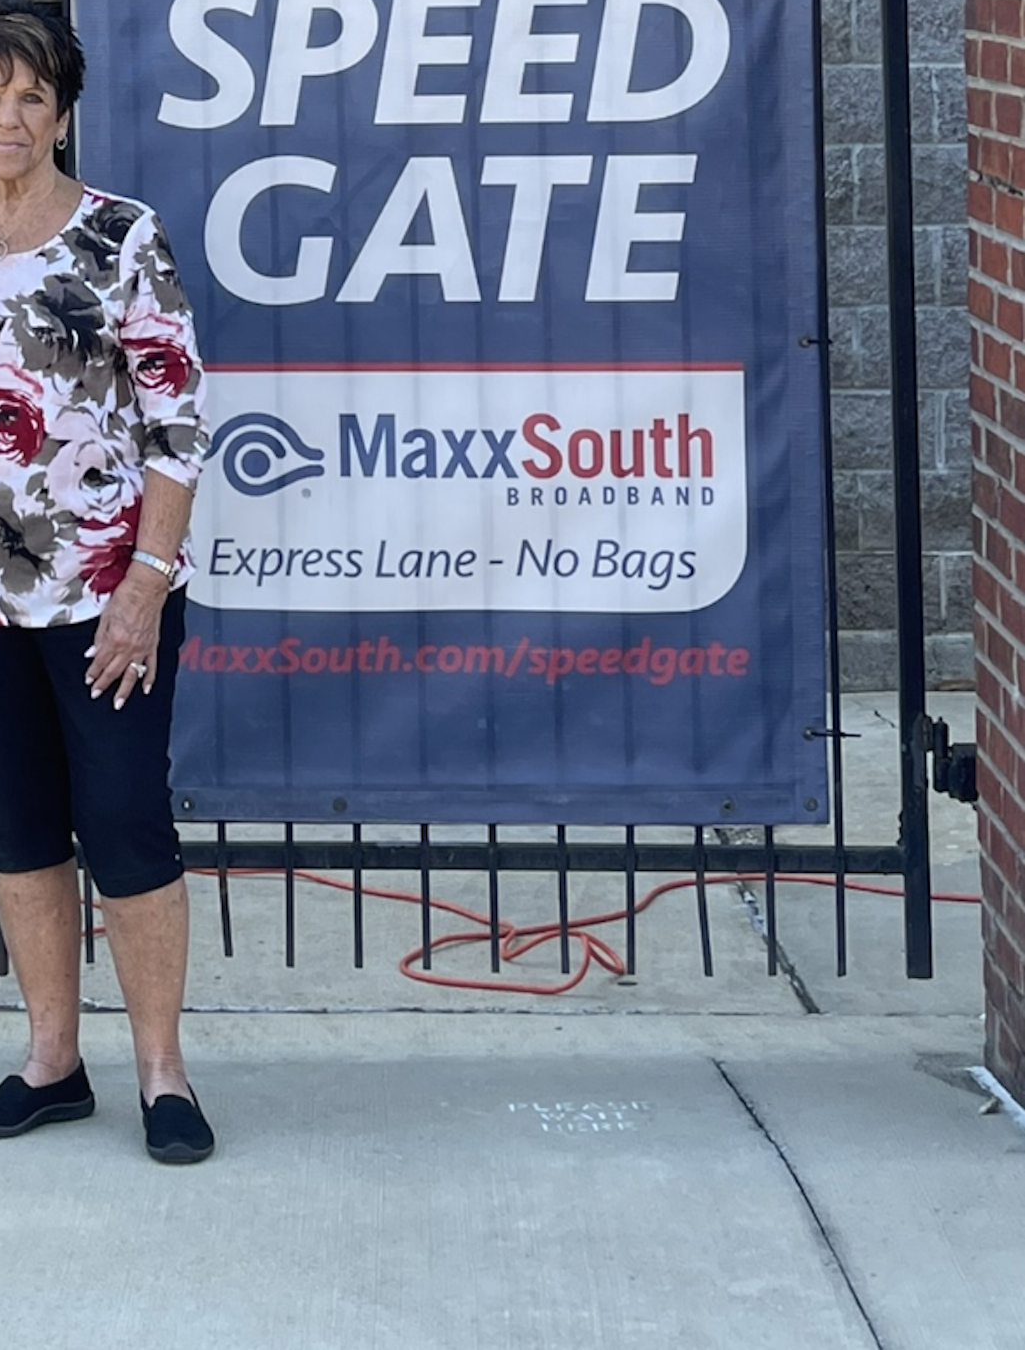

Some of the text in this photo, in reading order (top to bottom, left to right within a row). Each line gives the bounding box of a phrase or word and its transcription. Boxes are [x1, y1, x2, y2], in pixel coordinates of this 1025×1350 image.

[203, 153, 698, 306] GATE
[339, 413, 715, 479] MaxxSouth
[506, 486, 716, 507] BROADBAND
[208, 538, 364, 586] Express
[375, 540, 476, 579] Lane
[517, 538, 579, 579] No
[591, 539, 698, 591] Bags
